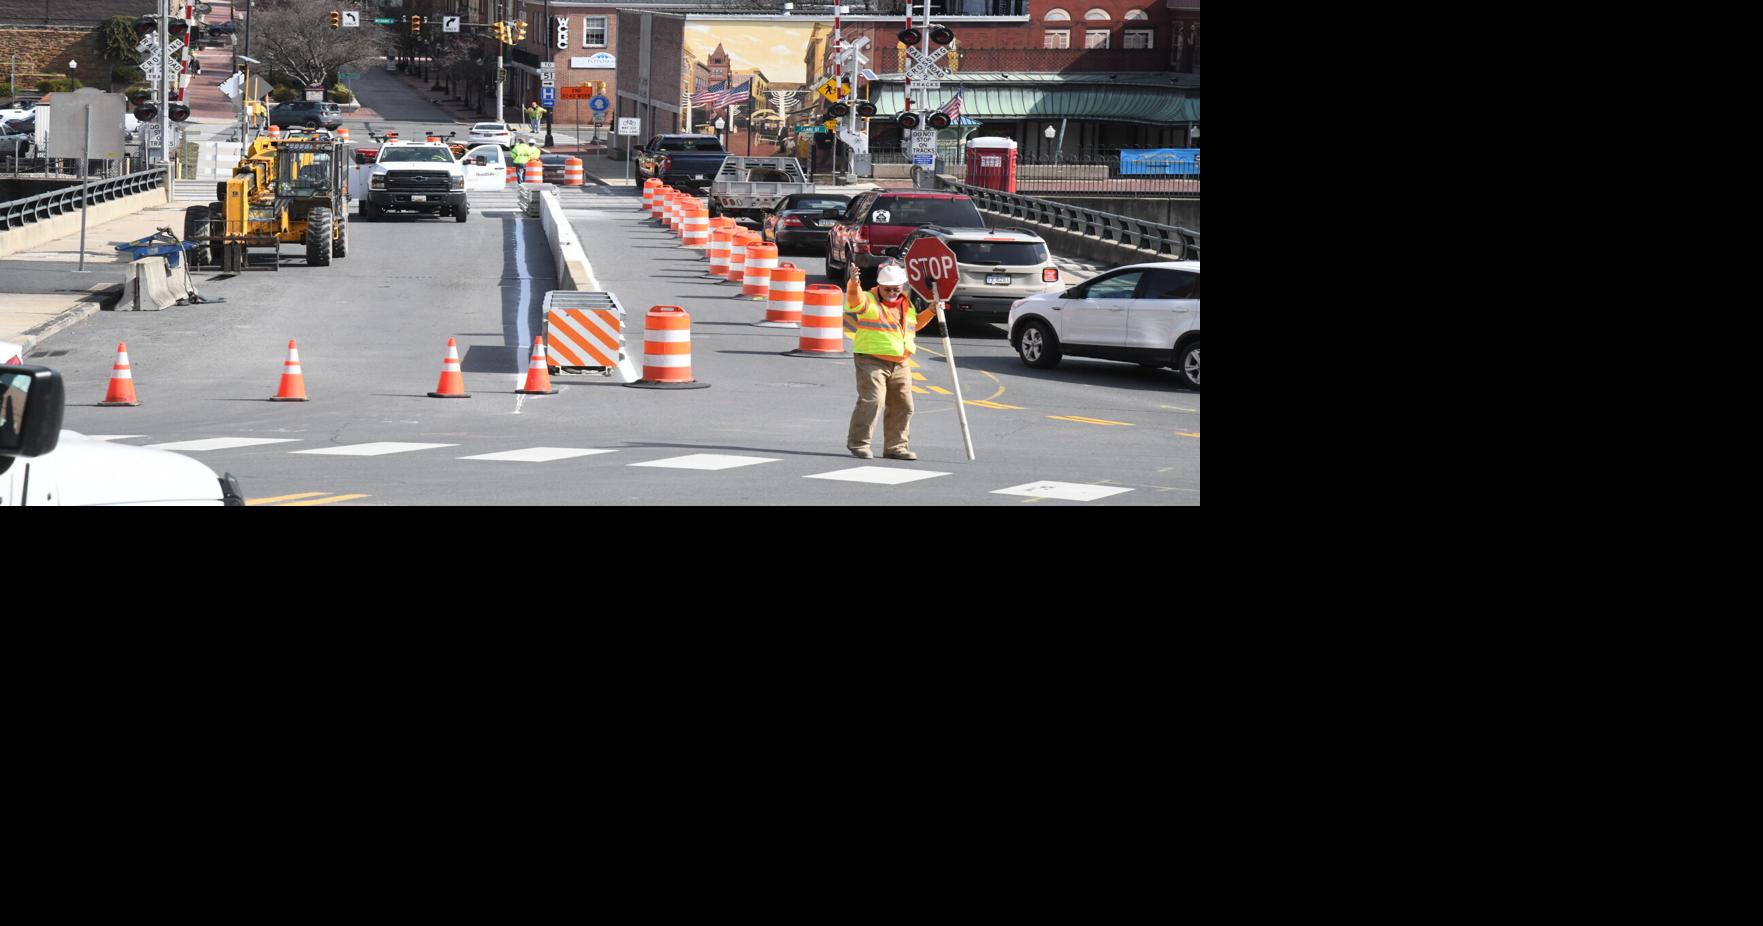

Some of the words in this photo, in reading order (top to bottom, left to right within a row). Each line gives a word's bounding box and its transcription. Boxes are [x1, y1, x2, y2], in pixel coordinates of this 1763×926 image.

[141, 40, 182, 70] CROING
[142, 39, 181, 71] RAILOAD
[906, 47, 946, 78] CROSSING
[908, 47, 945, 78] RAILROAD
[542, 88, 554, 99] H
[909, 256, 953, 281] STOP
